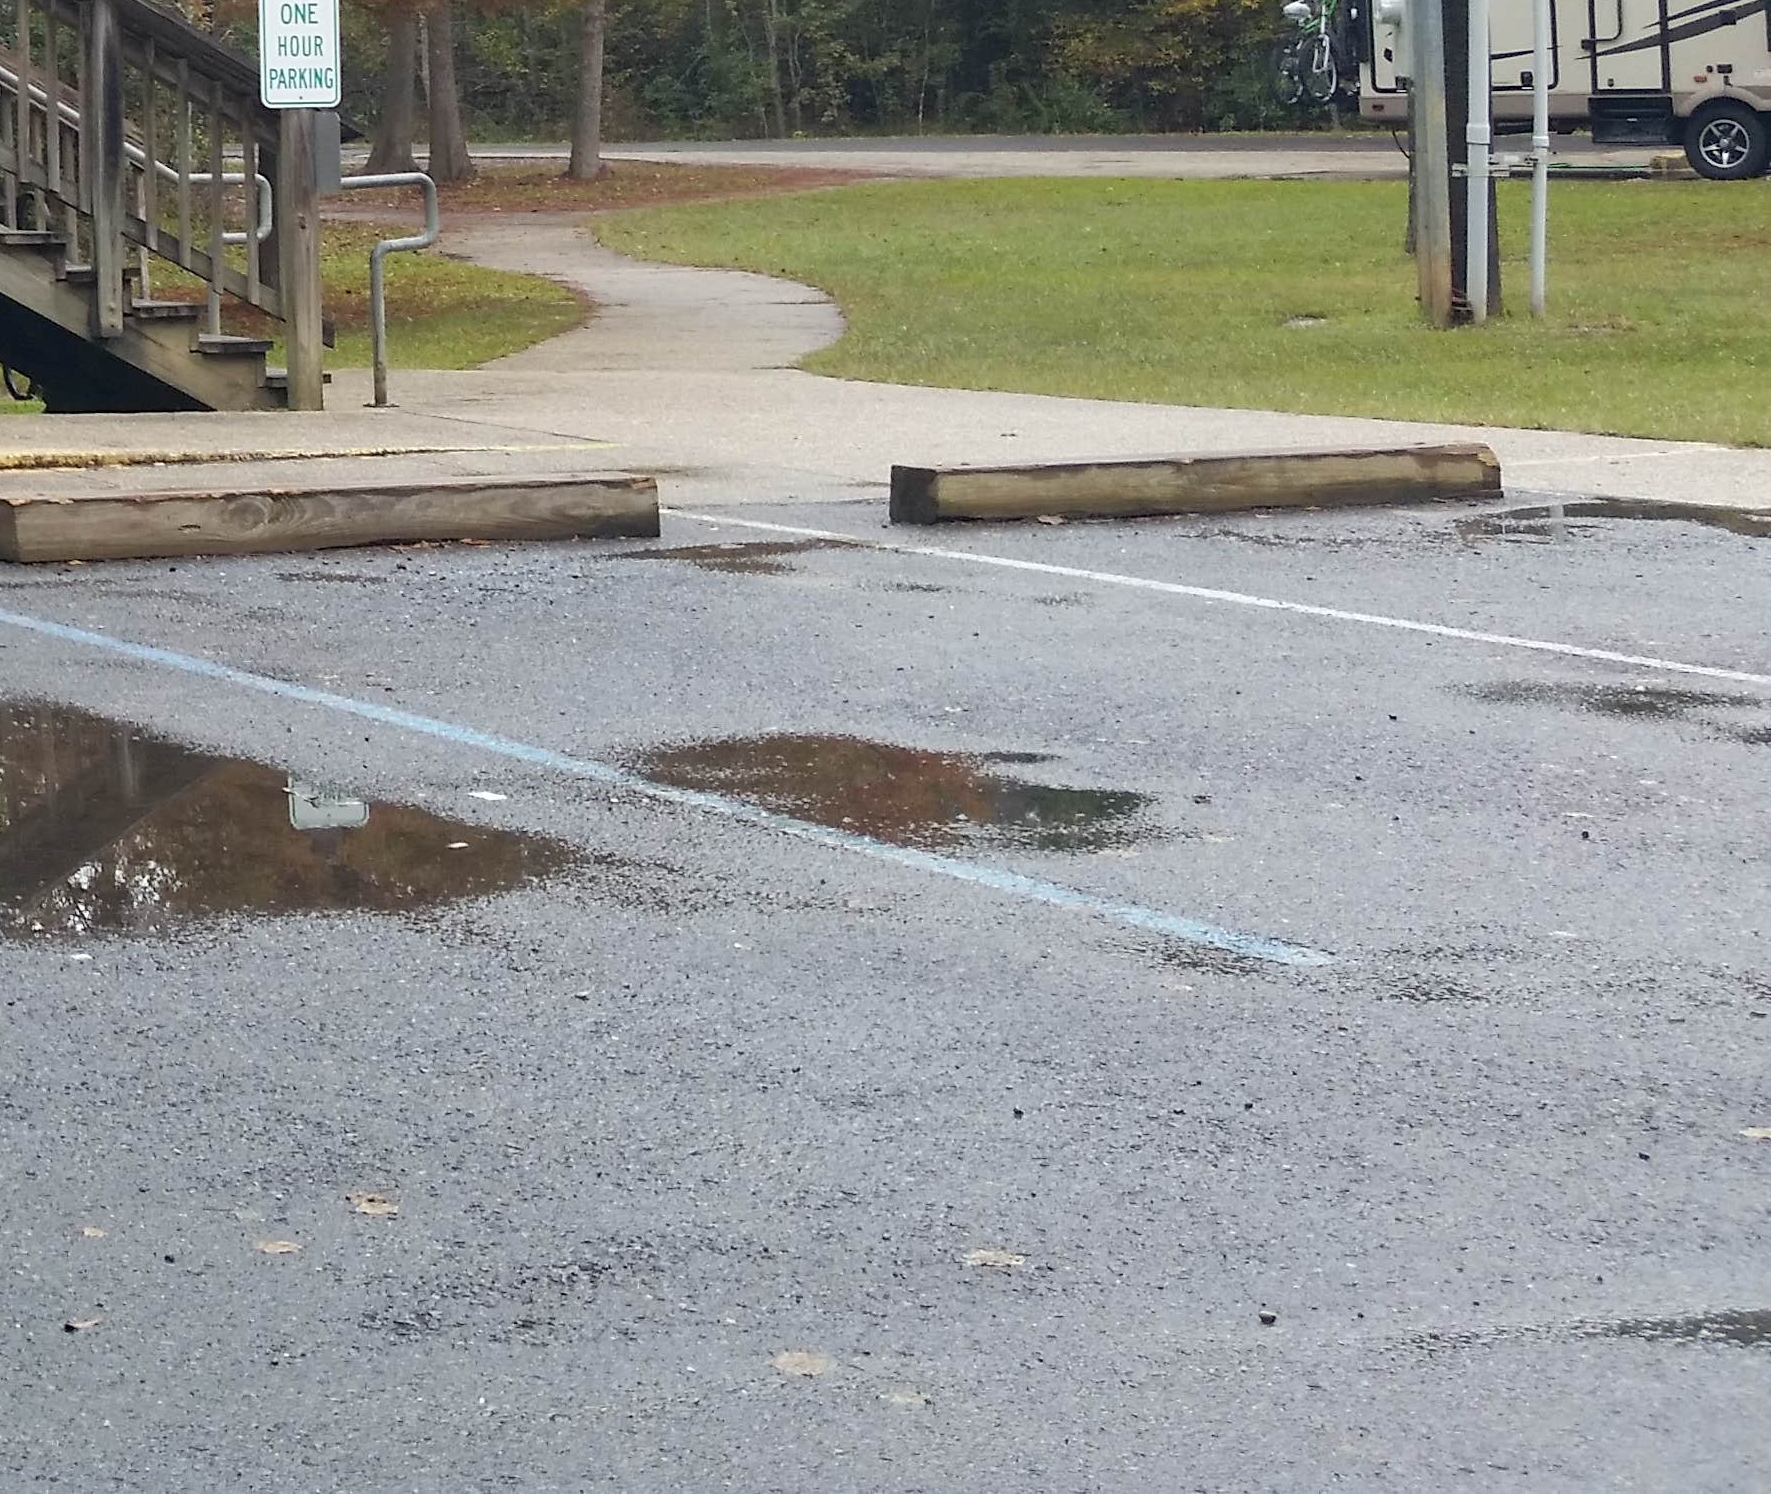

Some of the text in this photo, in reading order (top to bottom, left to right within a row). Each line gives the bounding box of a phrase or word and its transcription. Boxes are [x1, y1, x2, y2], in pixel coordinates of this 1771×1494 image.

[280, 2, 319, 24] ONE
[277, 35, 324, 57] HOUR
[269, 67, 334, 89] PARKING
